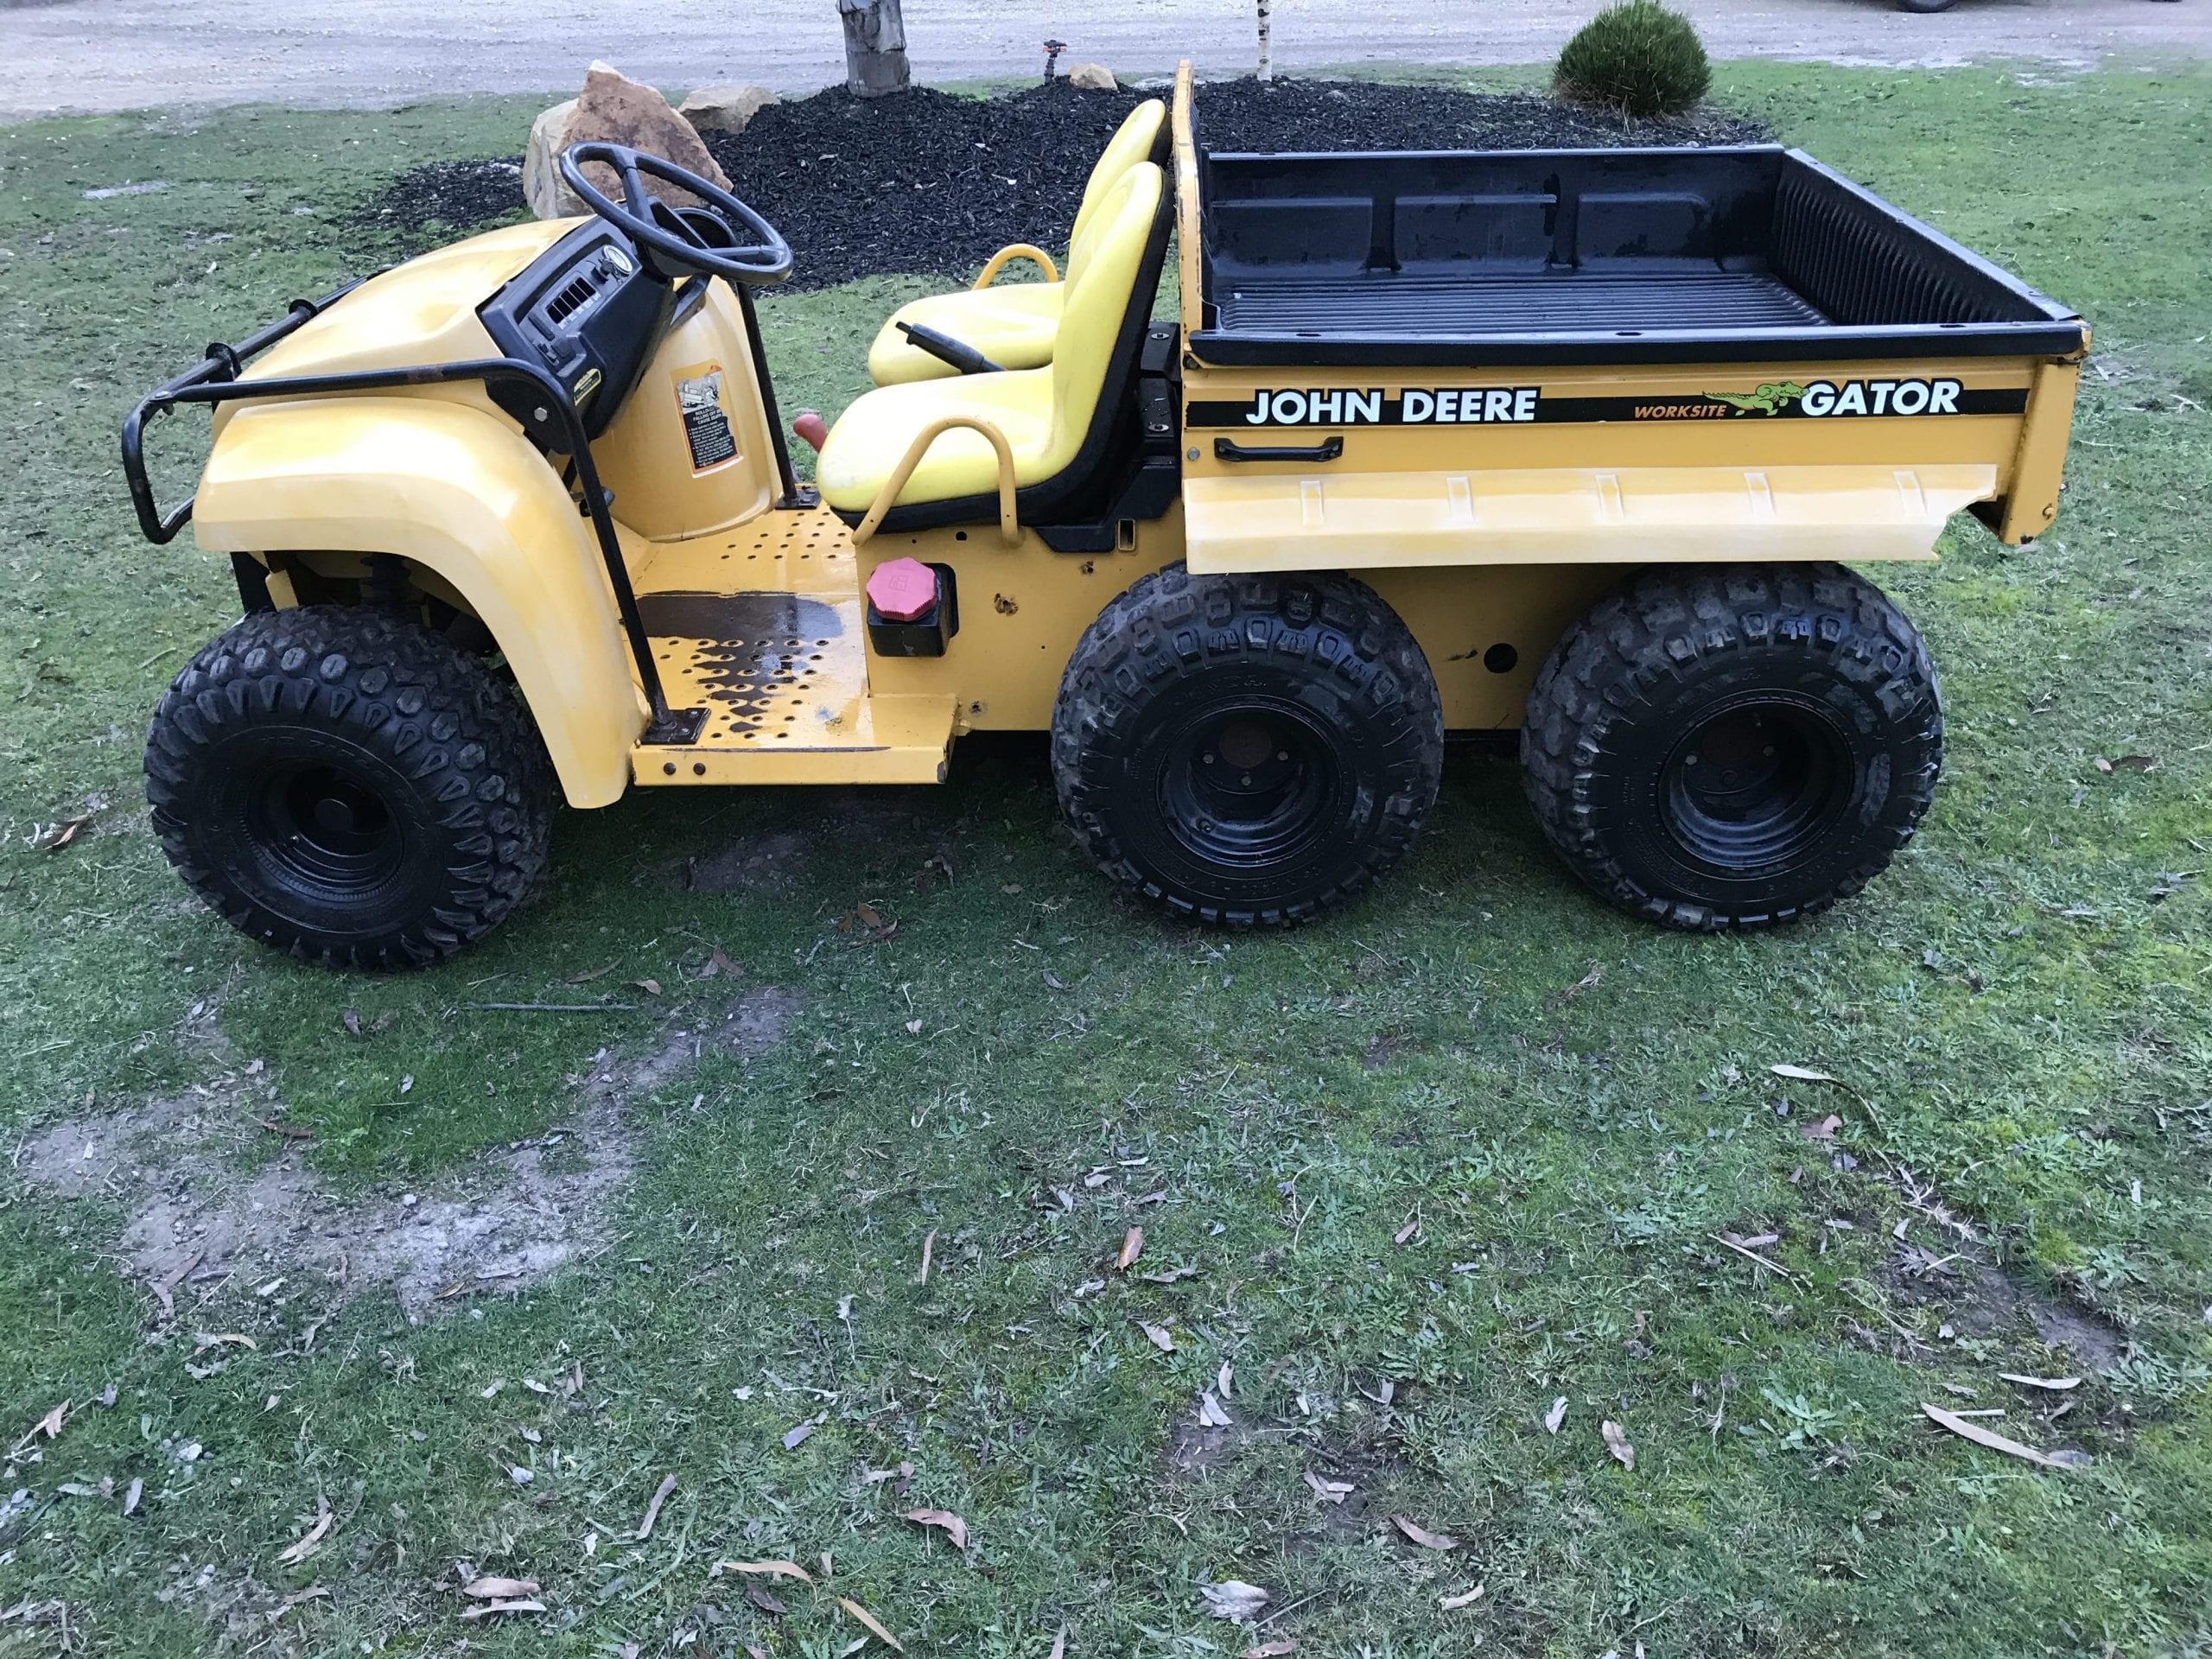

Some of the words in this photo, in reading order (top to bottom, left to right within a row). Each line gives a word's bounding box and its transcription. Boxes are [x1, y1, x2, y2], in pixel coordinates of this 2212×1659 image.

[1245, 391, 1382, 424] JOHN
[1402, 389, 1538, 423] DEERE
[1634, 404, 1727, 419] WORKSITE
[1800, 382, 1959, 416] GATOR
